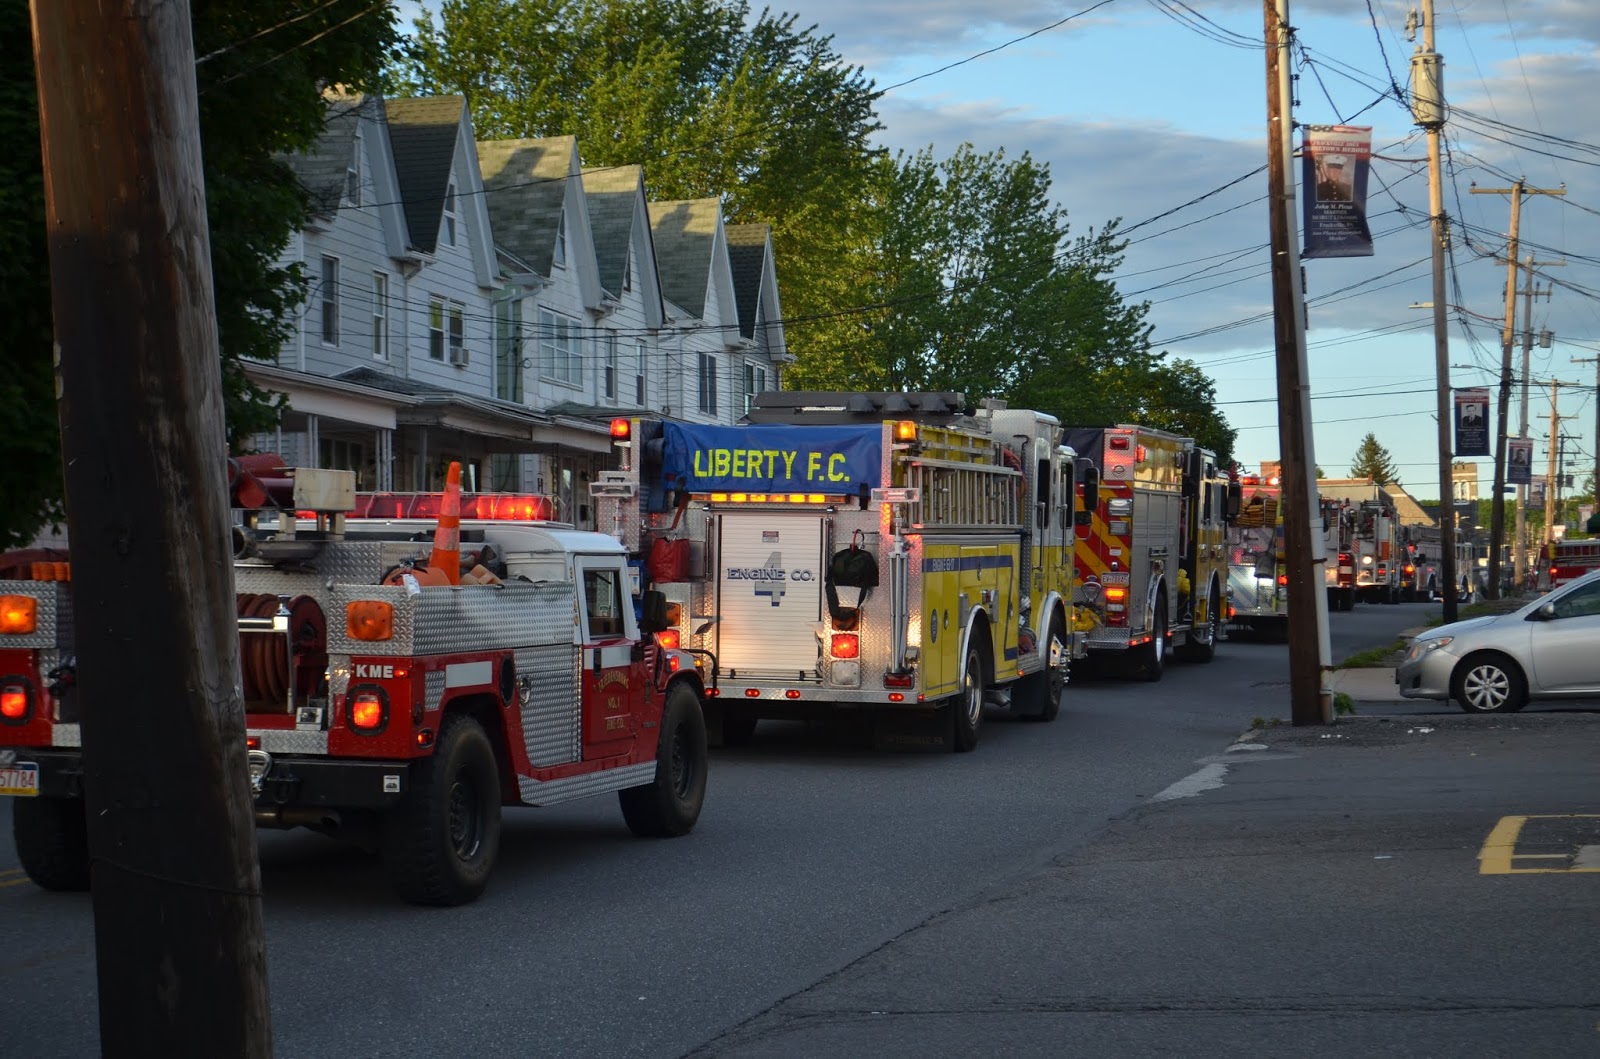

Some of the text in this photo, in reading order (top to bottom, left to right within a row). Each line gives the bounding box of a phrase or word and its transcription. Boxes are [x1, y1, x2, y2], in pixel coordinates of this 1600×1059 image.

[693, 449, 851, 482] LIBERTY F.C.
[727, 568, 816, 582] ENGINE CO.
[356, 664, 394, 679] KME
